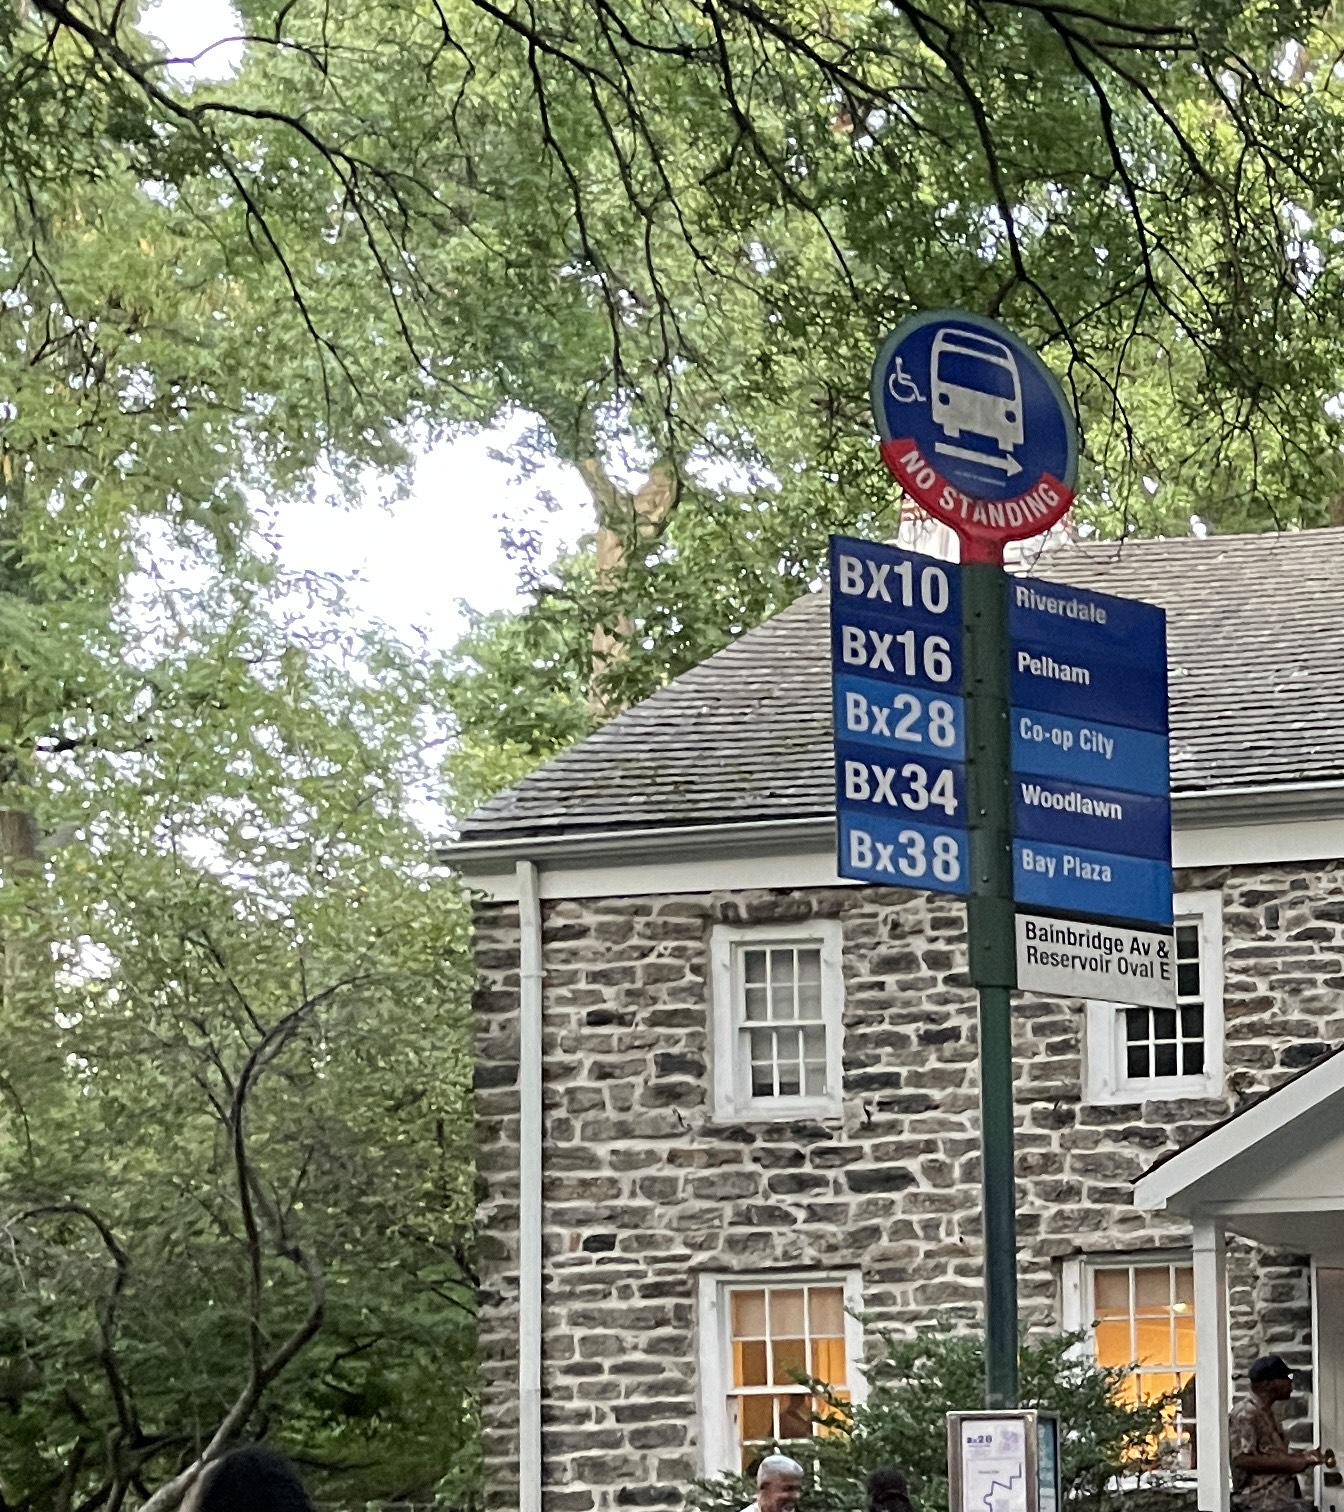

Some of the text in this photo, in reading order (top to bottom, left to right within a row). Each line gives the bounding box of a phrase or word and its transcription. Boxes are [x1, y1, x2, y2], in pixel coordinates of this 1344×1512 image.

[900, 450, 1060, 528] NO STANDING
[839, 554, 949, 615] BX10
[1015, 586, 1107, 624] Riverdale
[841, 625, 952, 683] BX16
[1017, 652, 1091, 686] Pelham
[845, 692, 956, 748] Bx28
[1020, 717, 1115, 760] Co-op City
[844, 760, 958, 816] BX34
[1021, 783, 1123, 821] Woodlawn
[849, 830, 960, 883] Bx38
[1022, 849, 1112, 883] Bay Plaza
[1025, 921, 1170, 959] Bainbridge Av &
[1027, 945, 1171, 981] Reservoir Oval E
